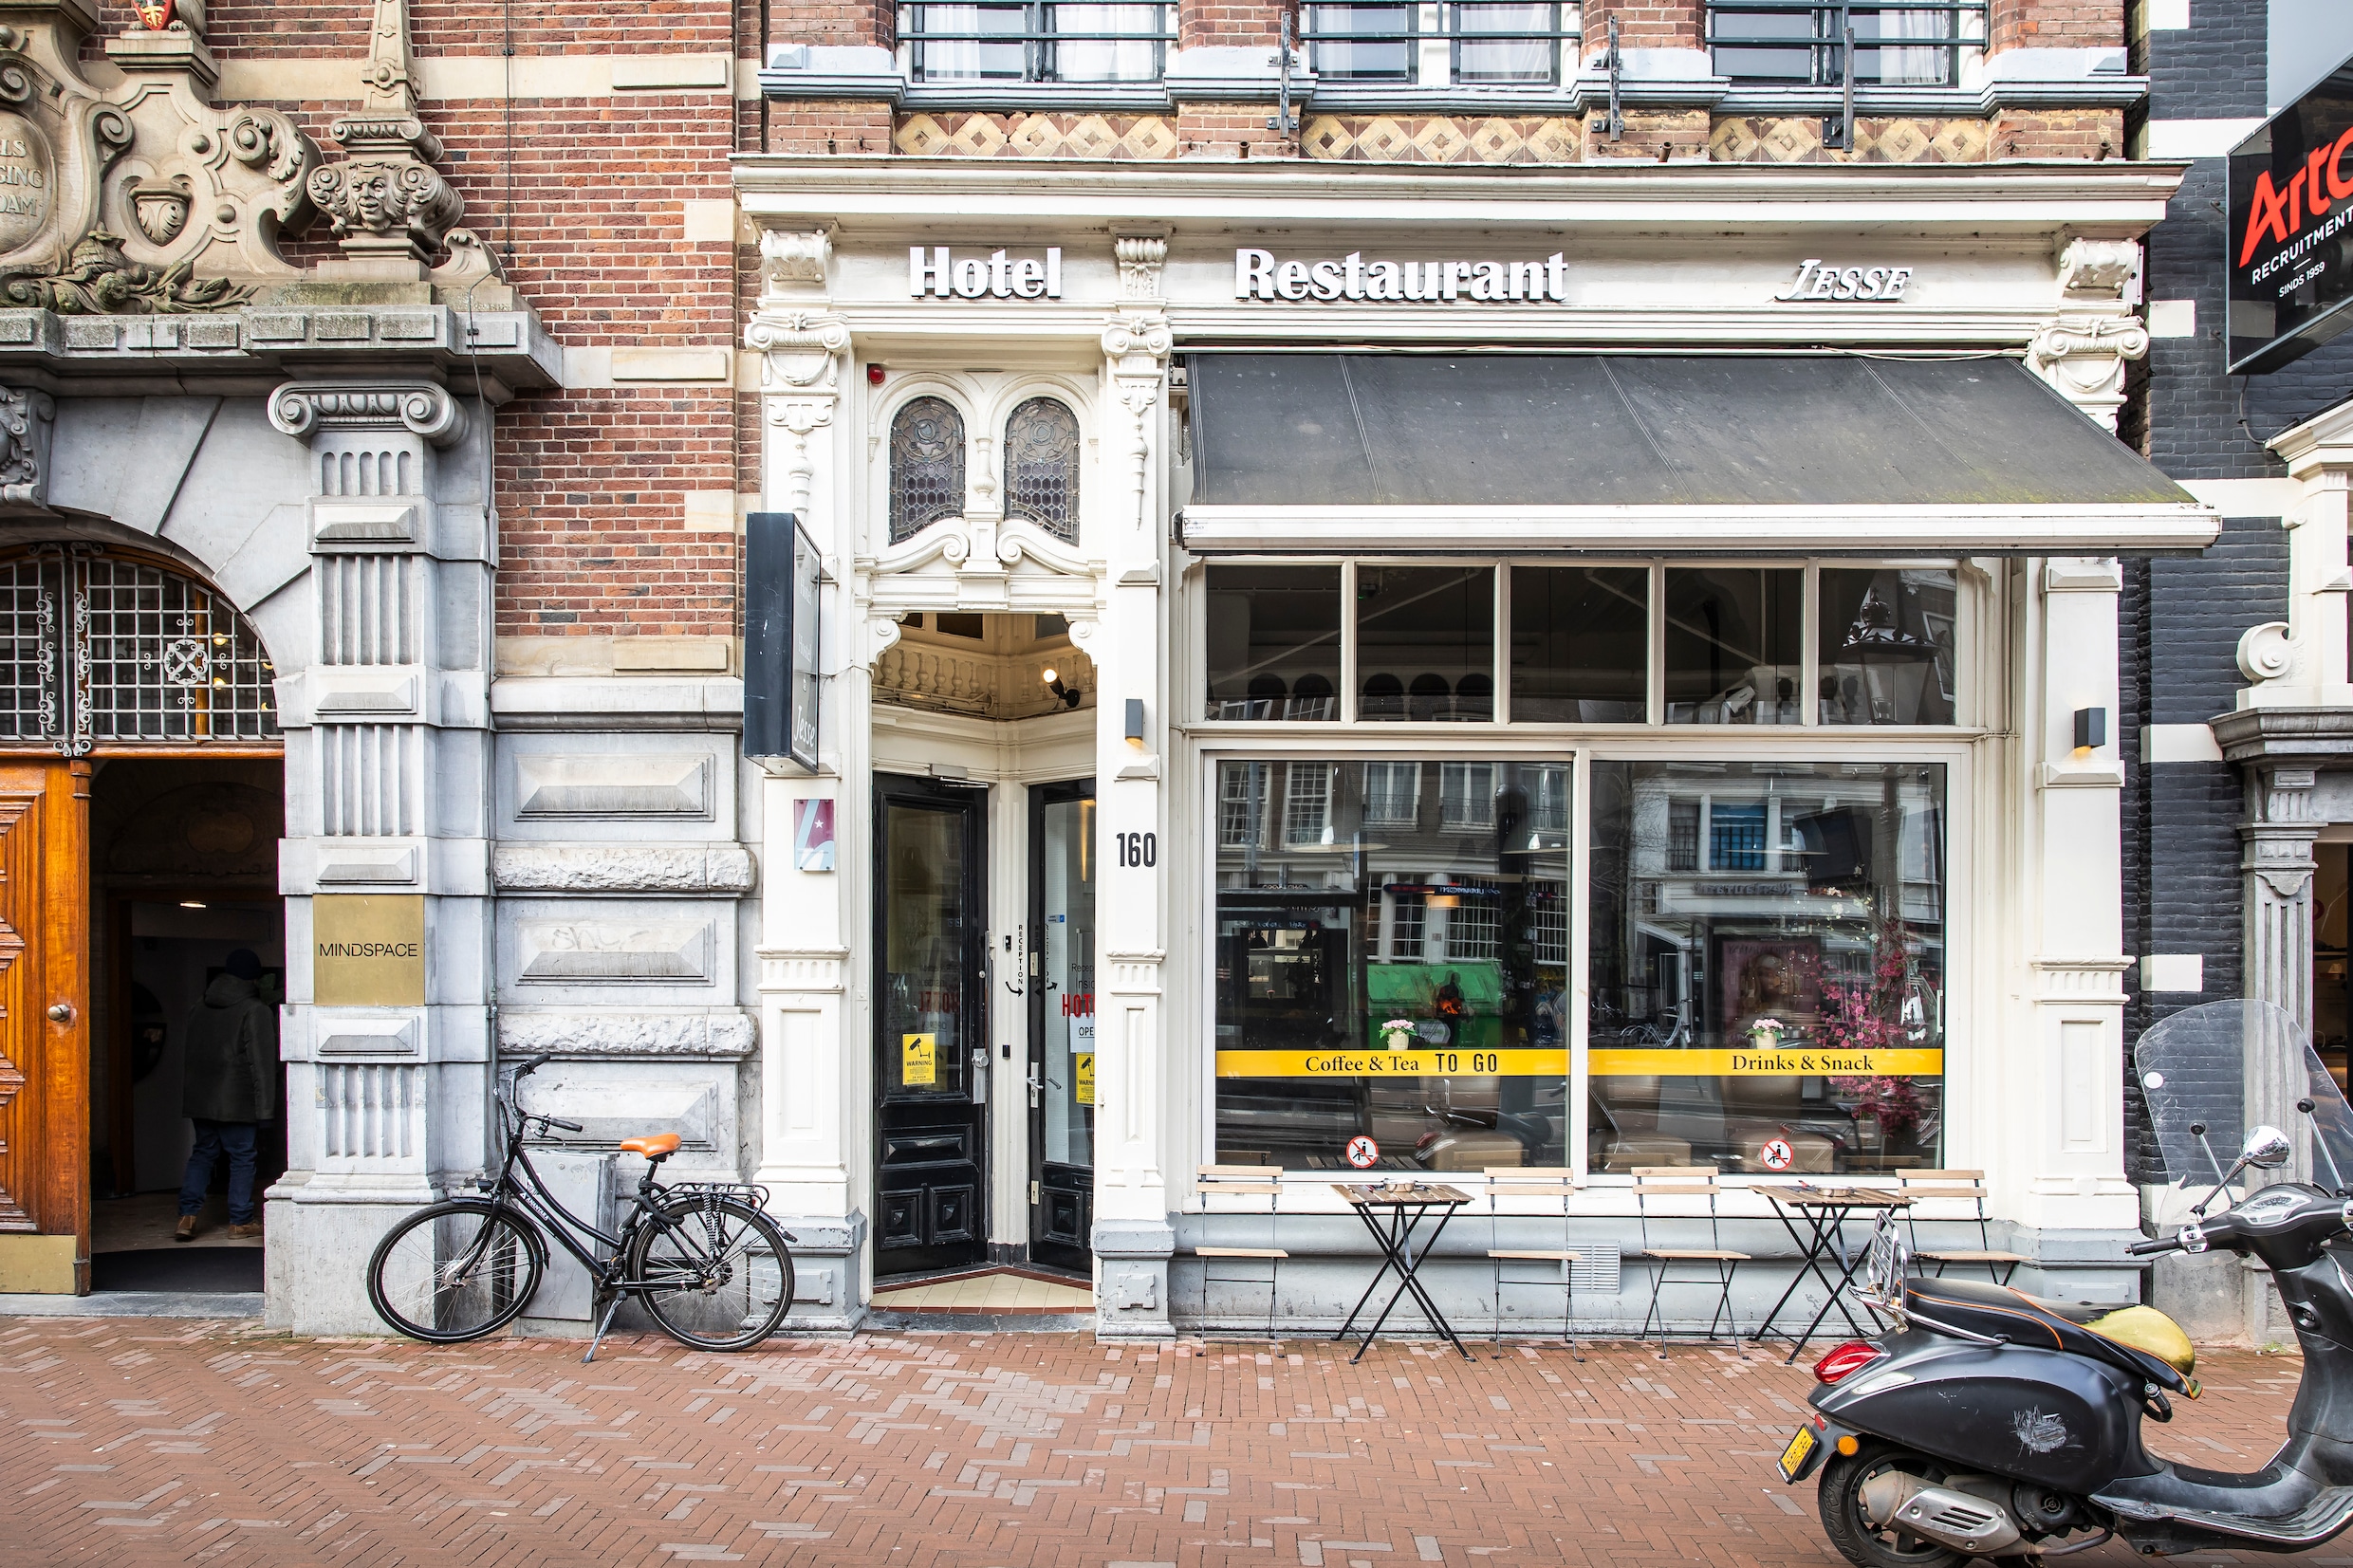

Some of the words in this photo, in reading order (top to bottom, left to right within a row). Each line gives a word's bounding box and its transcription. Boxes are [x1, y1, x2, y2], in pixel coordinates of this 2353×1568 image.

[2251, 205, 2353, 285] RECRUITMENT
[910, 247, 1062, 299] Hotel
[1234, 248, 1567, 302] Restaurant
[2278, 274, 2305, 298] SINDS
[2306, 261, 2325, 284] 1959
[800, 575, 812, 606] Hotel
[798, 633, 812, 664] Hostel
[793, 704, 816, 747] Jesse
[1116, 832, 1157, 868] 160
[320, 943, 418, 957] MINDSPACE
[1062, 993, 1095, 1018] HOT
[1306, 1055, 1363, 1072] Coffee
[1369, 1055, 1383, 1072] &
[1388, 1055, 1419, 1071] Tea
[1435, 1052, 1458, 1073] TO
[1473, 1052, 1497, 1073] GO
[1732, 1055, 1795, 1071] Drinks
[1800, 1055, 1816, 1071] &
[1820, 1054, 1874, 1071] Snack
